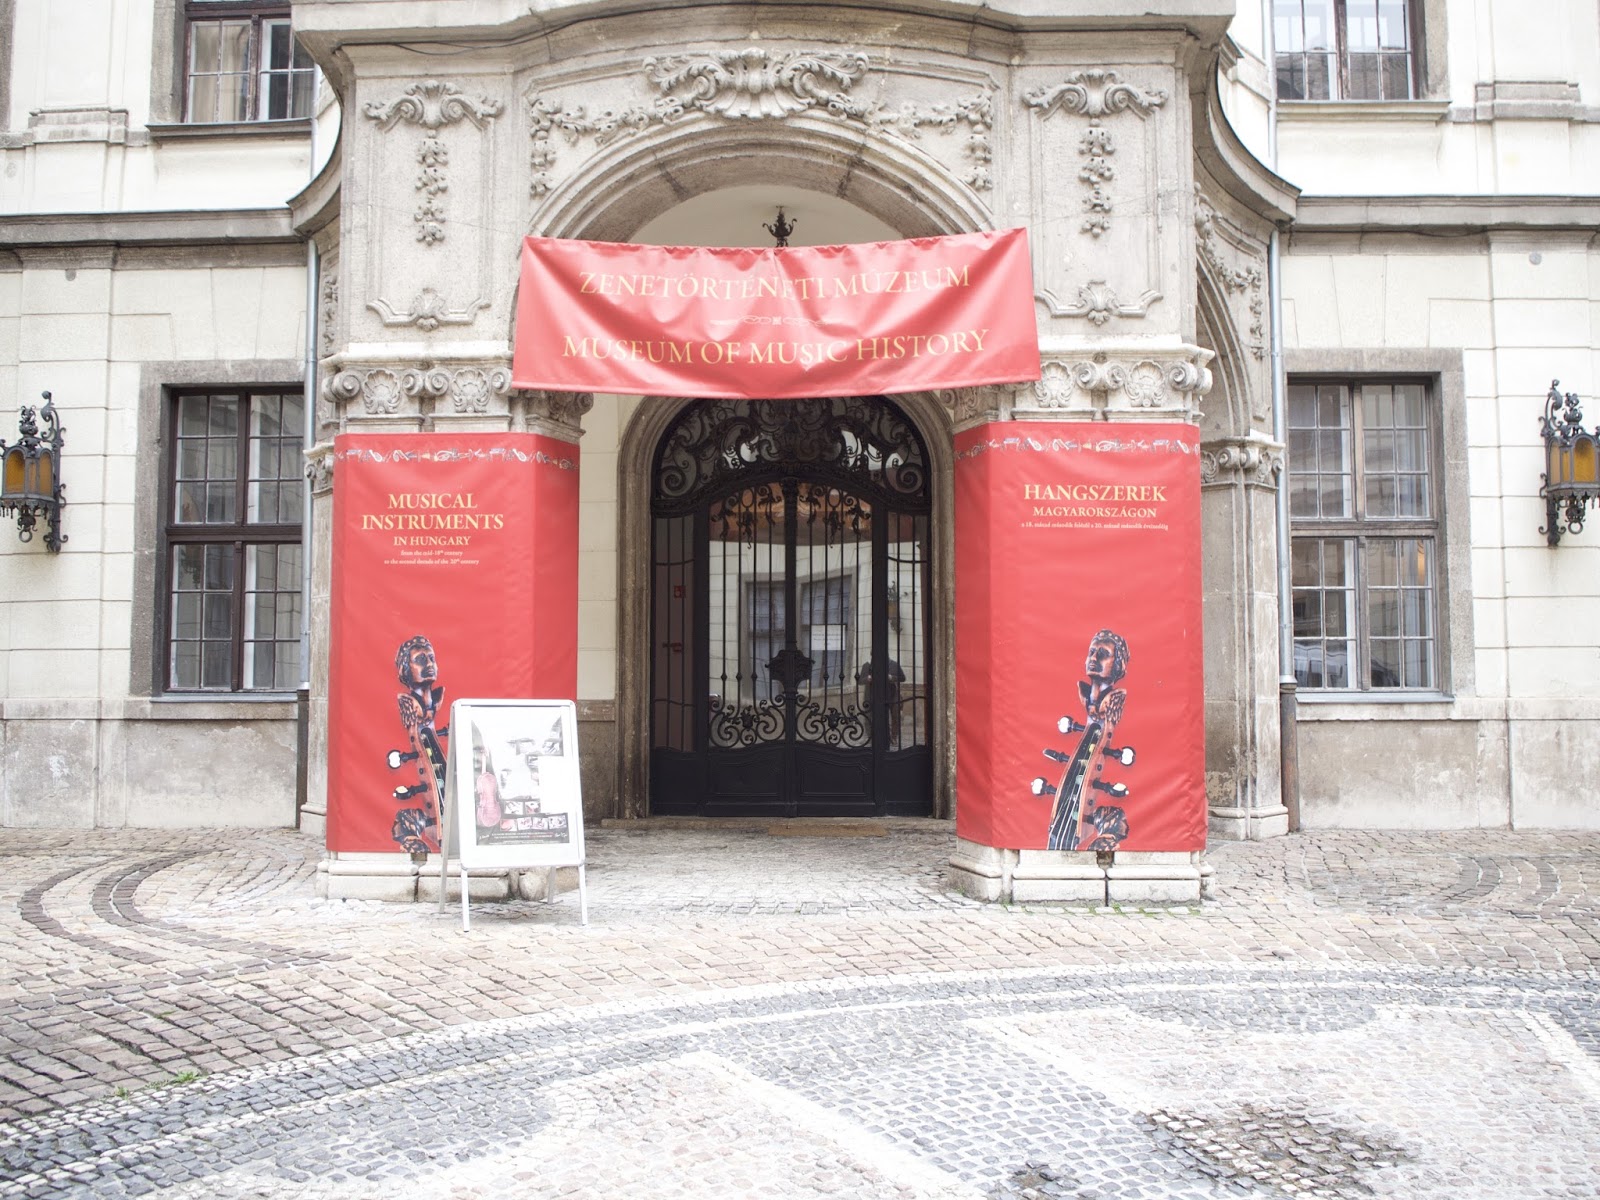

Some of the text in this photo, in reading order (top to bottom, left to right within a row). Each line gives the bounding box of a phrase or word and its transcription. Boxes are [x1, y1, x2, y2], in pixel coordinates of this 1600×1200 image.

[579, 263, 971, 301] ZENETÖRTÉNETI MÚZEUM
[562, 328, 990, 366] MUSEUM OF MUSIC HISTORY
[387, 493, 478, 510] MUSICAL
[1023, 483, 1168, 502] HANGSZEREK
[1032, 506, 1157, 518] MAGYARORSZÁGON
[361, 513, 504, 531] INSTRUMENTS
[393, 535, 471, 546] IN HUNGARY
